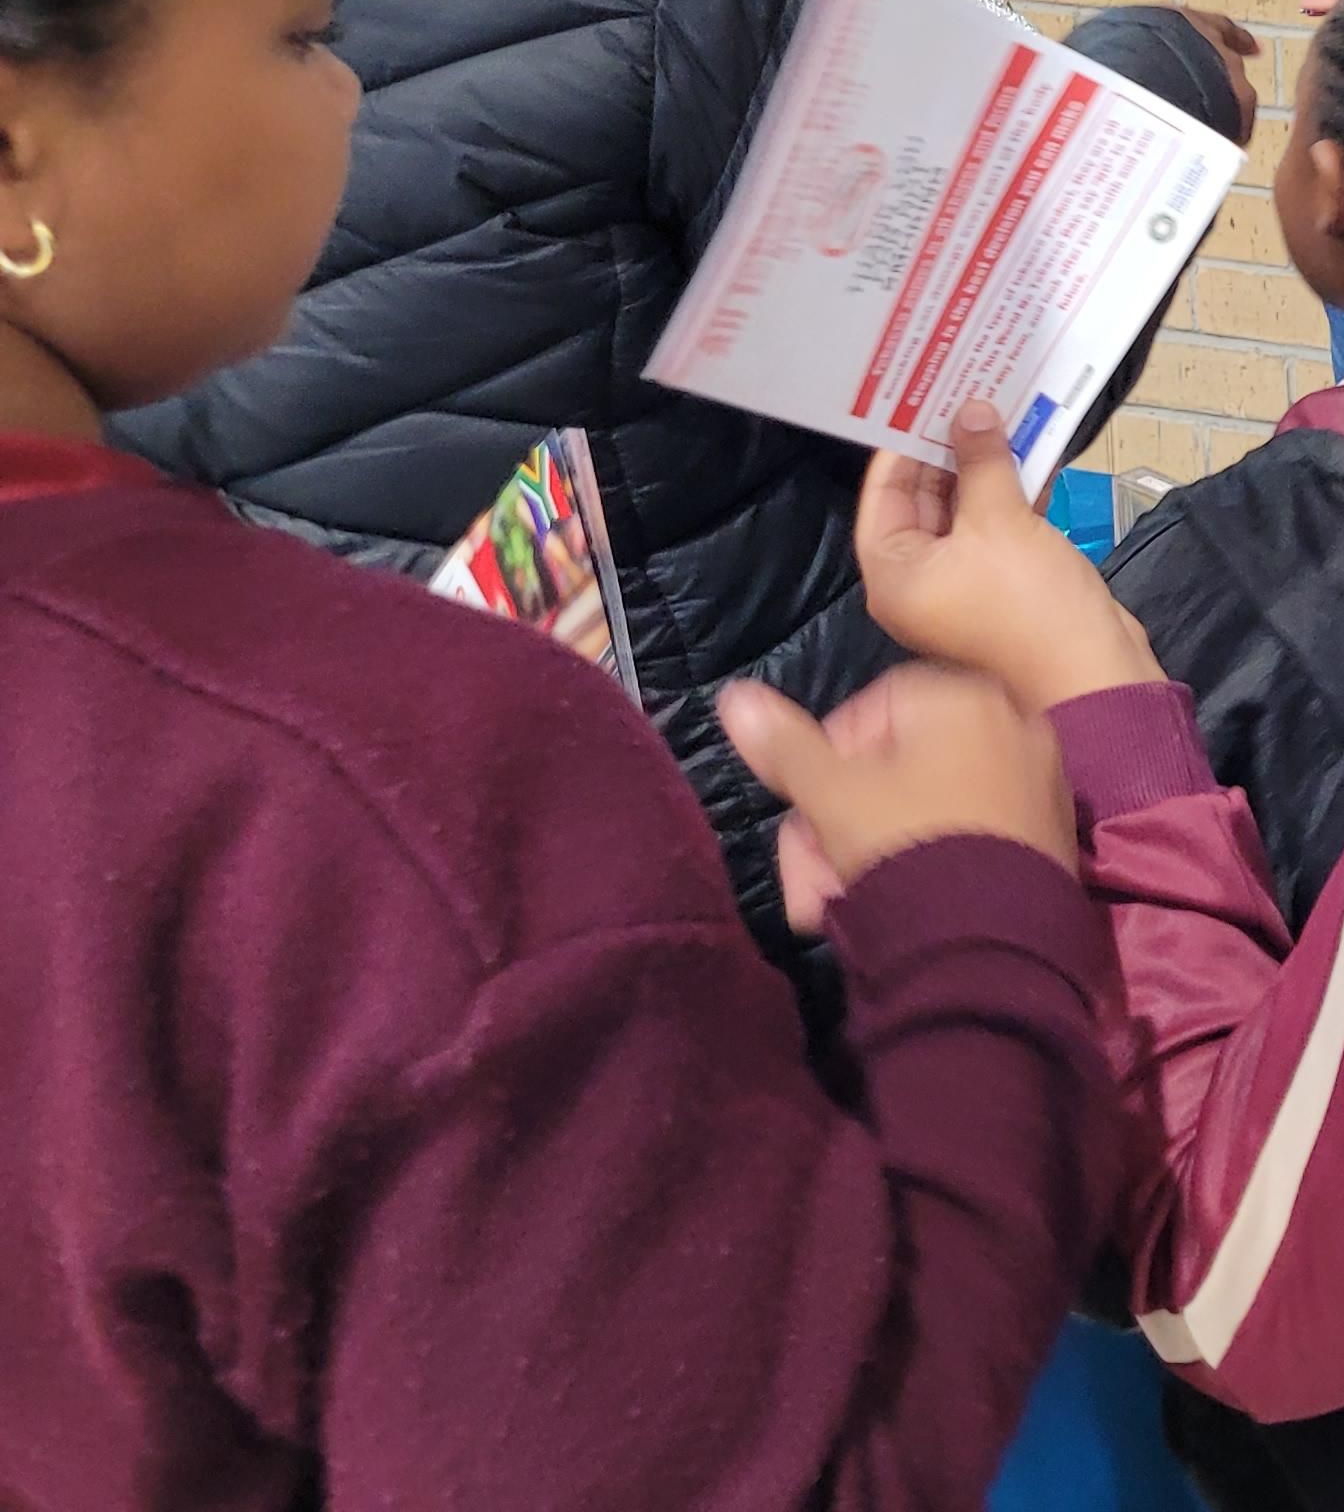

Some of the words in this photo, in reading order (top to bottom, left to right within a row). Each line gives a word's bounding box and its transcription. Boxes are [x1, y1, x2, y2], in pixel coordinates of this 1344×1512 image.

[1047, 95, 1086, 143] make
[1031, 136, 1061, 172] can
[1016, 166, 1045, 201] you
[980, 194, 1029, 263] decision
[961, 258, 993, 298] best
[947, 293, 974, 325] the
[939, 321, 958, 341] is
[903, 336, 954, 409] Stopping
